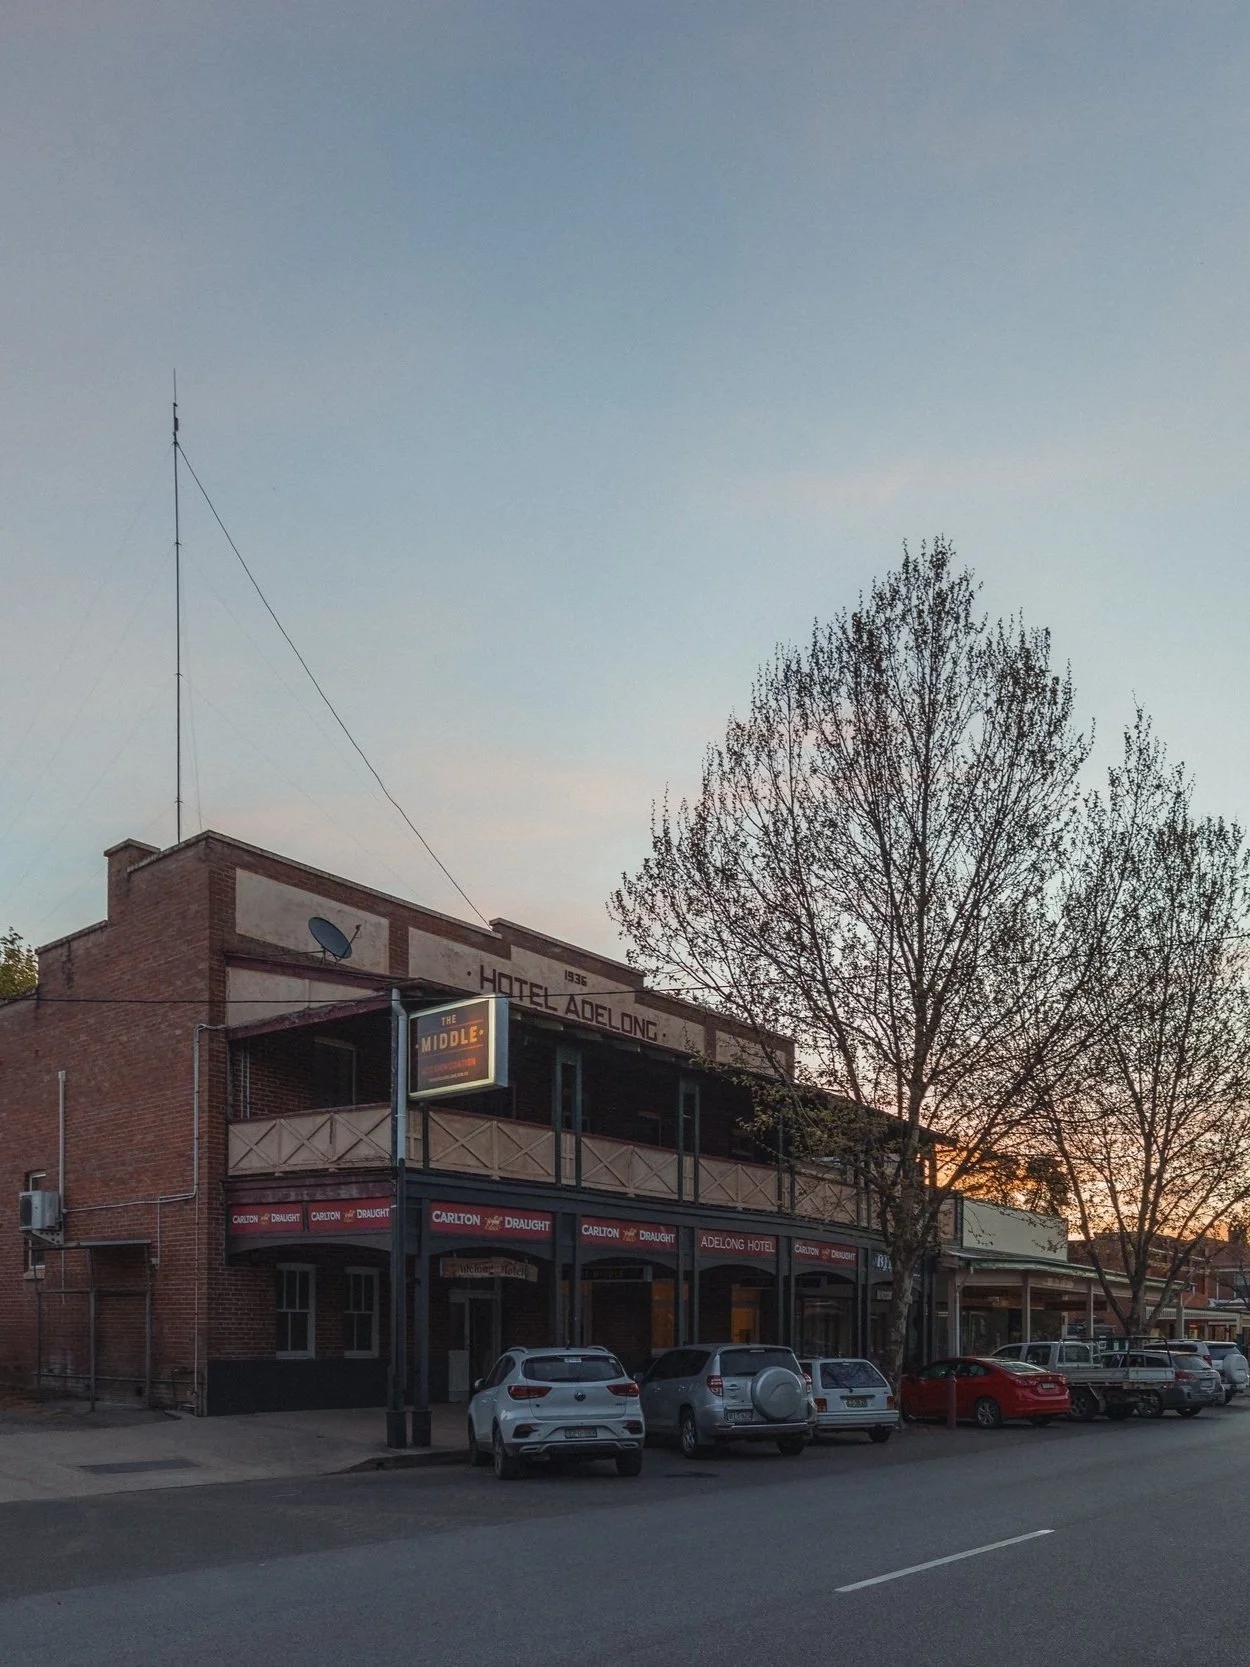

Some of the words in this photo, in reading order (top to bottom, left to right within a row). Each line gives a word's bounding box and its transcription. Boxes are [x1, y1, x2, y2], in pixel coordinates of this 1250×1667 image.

[564, 969, 588, 987] 1936
[479, 964, 558, 1012] HOTEL
[565, 994, 658, 1042] ADELONG
[441, 1013, 457, 1025] THE
[420, 1025, 478, 1053] MIDDLE
[232, 1214, 258, 1224] CARLTON
[271, 1212, 301, 1223] DRAUGHT
[311, 1210, 341, 1221] CARLTON
[356, 1207, 390, 1219] DRAUGHT
[432, 1210, 481, 1226] CARLTON
[504, 1217, 550, 1232] DRAUGHT
[581, 1224, 620, 1238] CARLTON
[639, 1230, 676, 1243] DRAUGHT
[700, 1235, 745, 1250] ADELONG
[747, 1240, 775, 1253] HOTEL
[794, 1244, 819, 1256] CARLTON
[831, 1248, 856, 1261] DRAUGHT
